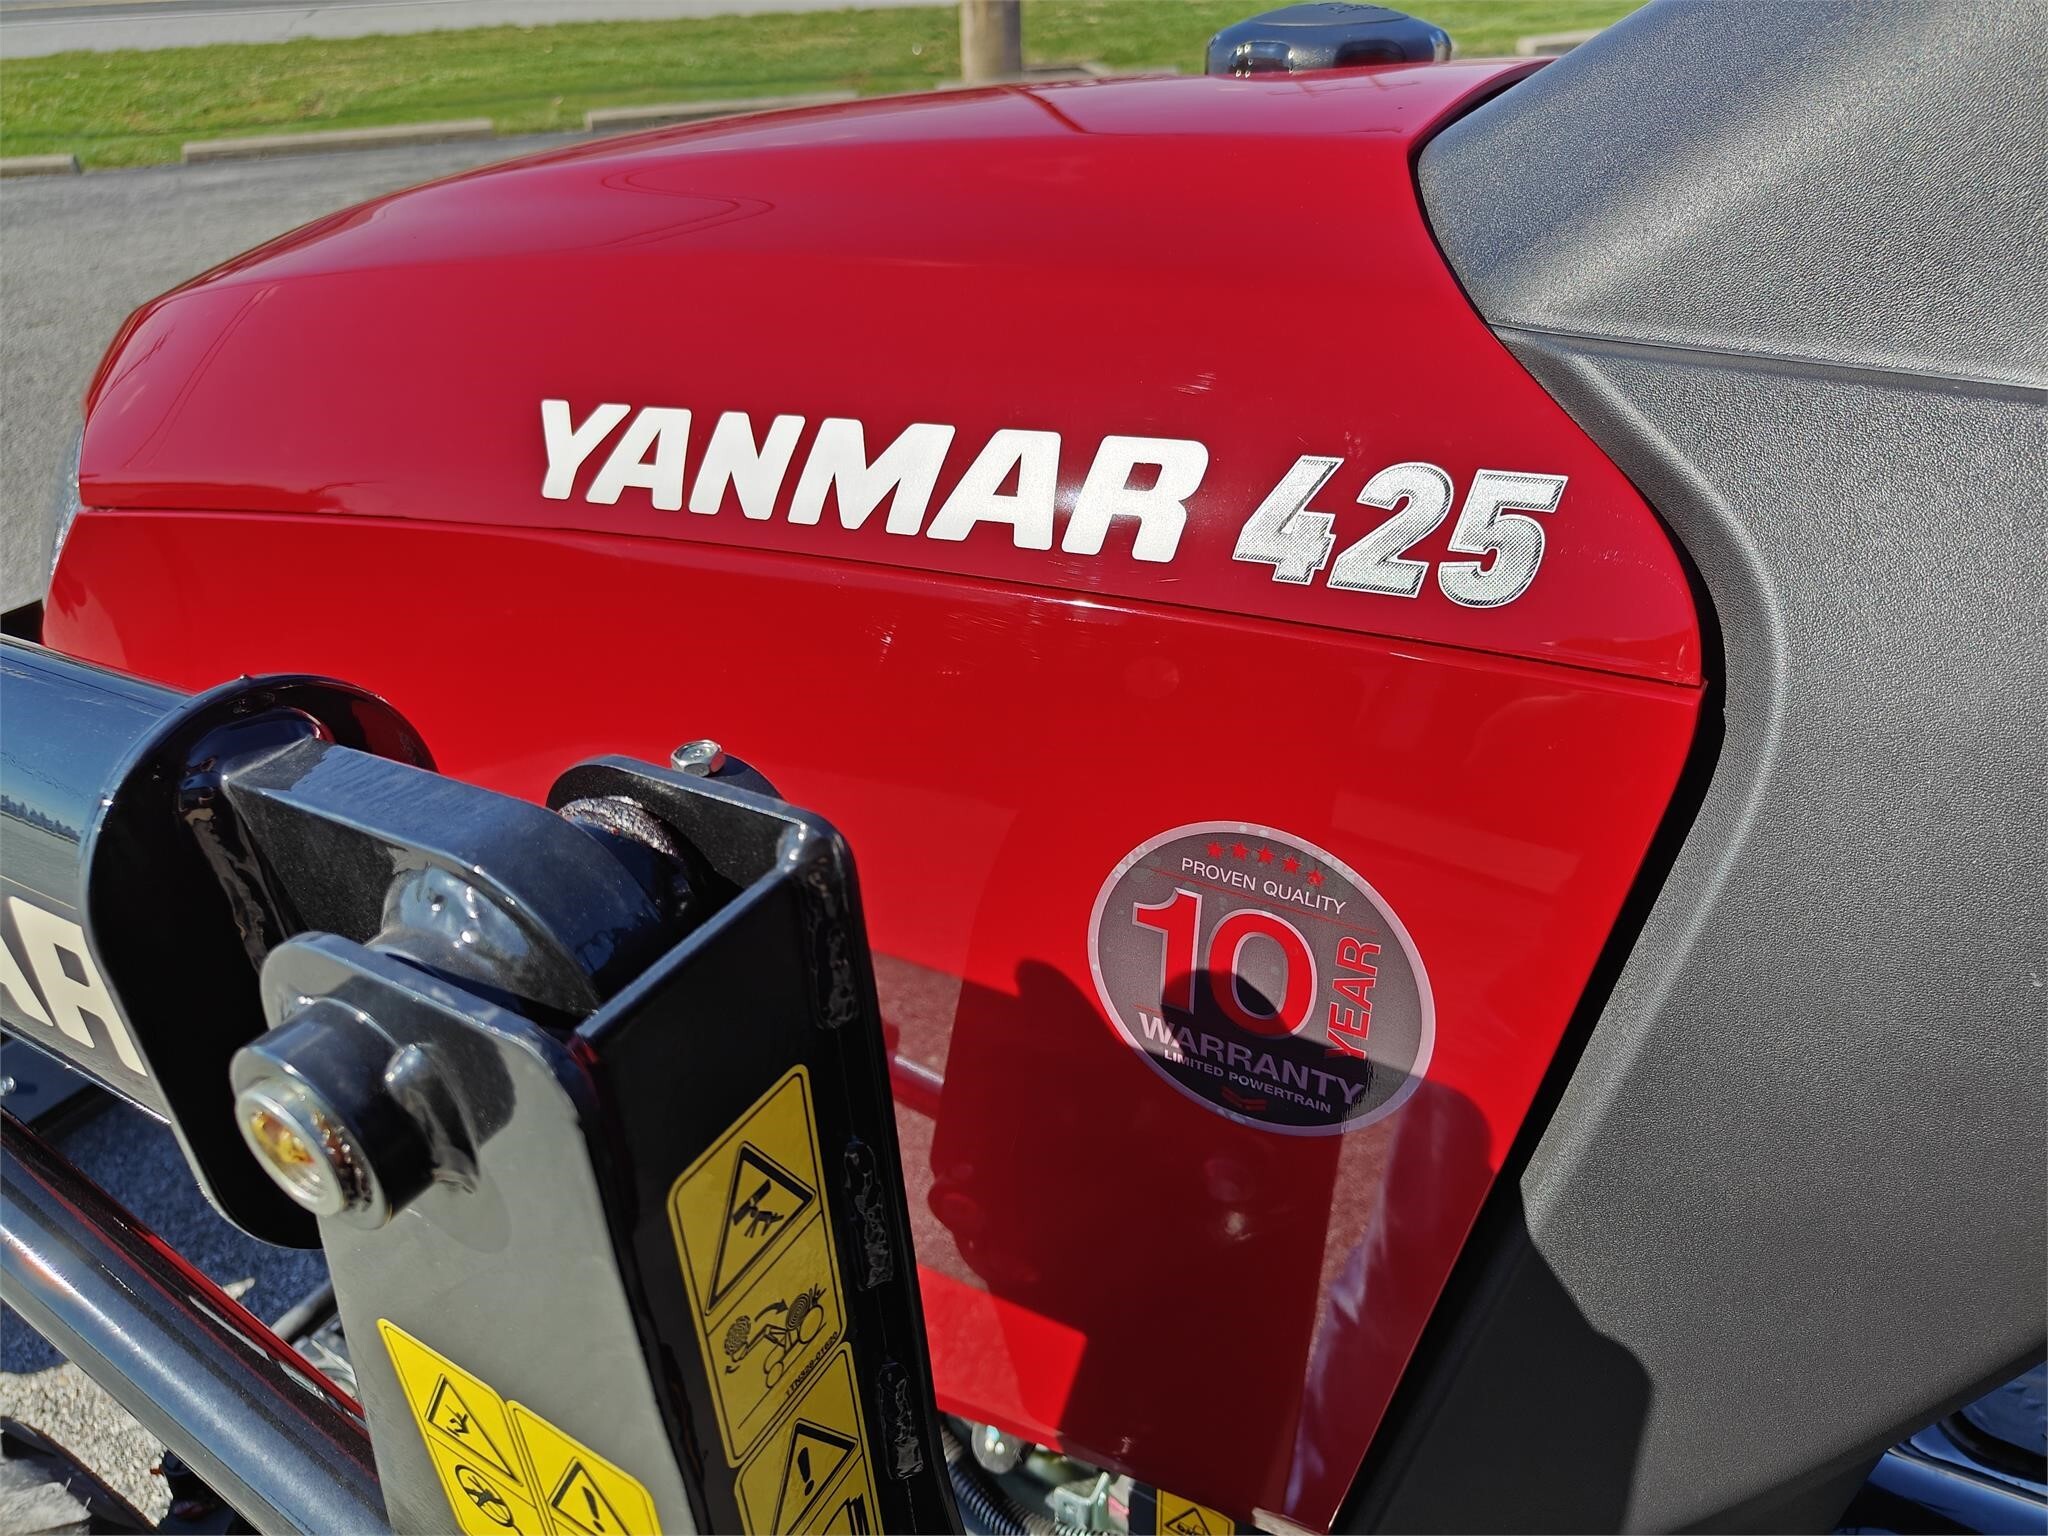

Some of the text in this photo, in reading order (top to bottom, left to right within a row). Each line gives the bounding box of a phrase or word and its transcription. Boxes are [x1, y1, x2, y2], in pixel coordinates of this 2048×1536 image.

[541, 399, 1569, 610] YANMAR 425
[1181, 857, 1347, 915] PROVEN QUALITY
[1131, 887, 1318, 1040] 10
[1325, 936, 1381, 1060] YEAR
[1138, 1011, 1366, 1106] WARRANTY
[1163, 1049, 1332, 1115] LIMITED POWERTRAIN
